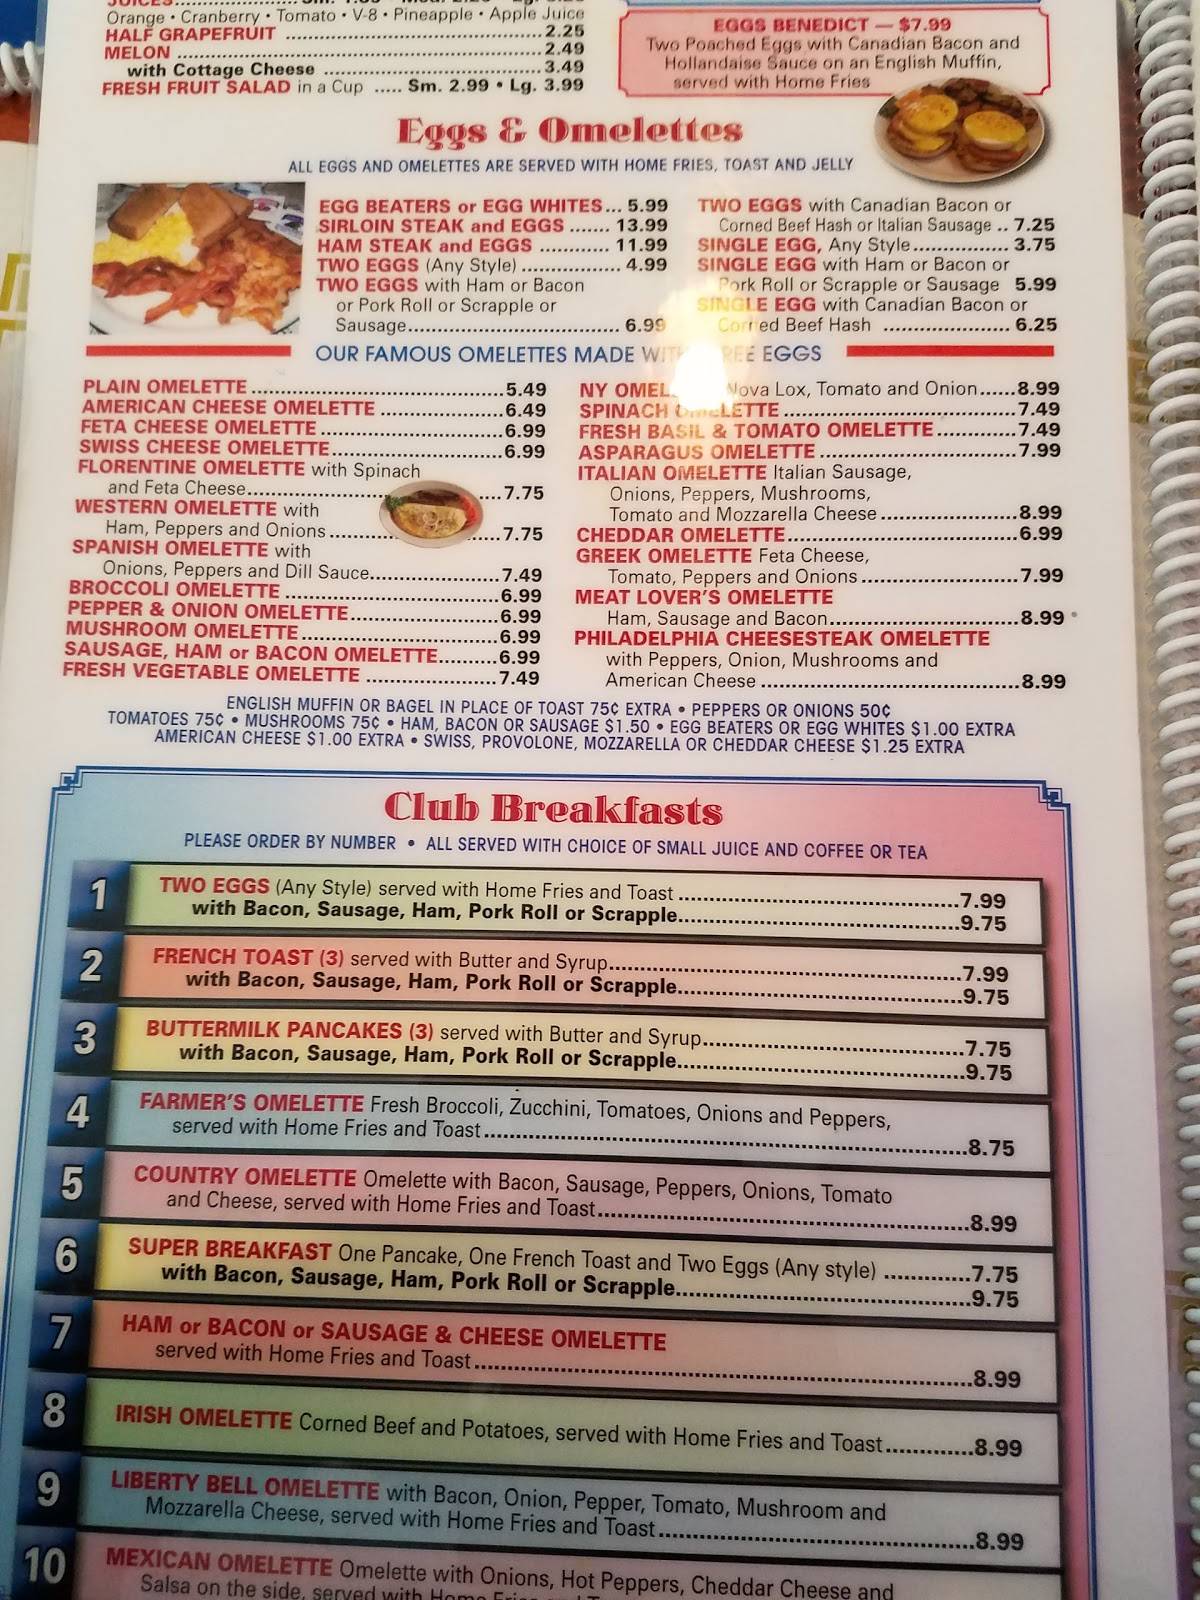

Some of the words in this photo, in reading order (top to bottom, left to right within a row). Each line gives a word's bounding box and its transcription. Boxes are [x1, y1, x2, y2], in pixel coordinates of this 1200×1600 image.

[106, 10, 166, 29] Orange
[180, 9, 261, 27] Cranberry
[276, 7, 336, 23] Tomato
[352, 7, 378, 22] V-8
[393, 6, 473, 25] Pineapple
[489, 5, 537, 24] Apple
[541, 4, 586, 21] Juice
[713, 17, 767, 34] EGGS
[772, 16, 870, 33] BENEDICT
[898, 16, 952, 35] $7.99
[105, 27, 156, 43] HALF
[158, 26, 277, 42] GRAPEFRUIT
[544, 23, 585, 38] 2.25
[646, 36, 680, 52] Two
[685, 36, 756, 52] Poached
[761, 35, 802, 55] Eggs
[806, 35, 843, 52] with
[848, 35, 927, 51] Canadian
[932, 34, 984, 51] Bacon
[988, 34, 1020, 51] and
[127, 63, 167, 78] with
[172, 62, 244, 80] Cottage
[250, 61, 315, 76] Cheese
[544, 59, 585, 74] 3.49
[665, 54, 762, 71] Hollandaise
[767, 54, 818, 70] Sauce
[822, 57, 844, 71] on
[849, 58, 870, 70] an
[874, 53, 936, 73] English
[942, 53, 1002, 71] Muffin,
[101, 80, 161, 96] FRESH
[166, 79, 221, 96] FRUIT
[226, 79, 291, 95] SALAD
[297, 79, 312, 94] in
[317, 82, 326, 94] a
[331, 78, 364, 97] Cup
[407, 77, 443, 93] Sm.
[449, 78, 490, 93] 2.99
[509, 77, 537, 96] Lg.
[544, 77, 584, 92] 3.99
[397, 116, 488, 152] Eggs
[498, 116, 528, 144] &
[538, 115, 744, 144] Omelettes
[287, 160, 313, 174] ALL
[318, 159, 358, 174] EGGS
[361, 159, 394, 174] AND
[398, 158, 481, 174] OMELETTES
[484, 158, 514, 173] ARE
[518, 158, 576, 173] SERVED
[580, 158, 619, 173] WITH
[624, 157, 668, 173] HOME
[672, 157, 718, 173] FRIES,
[724, 157, 770, 172] TOAST
[774, 157, 807, 172] AND
[811, 157, 854, 172] JELLY
[319, 199, 359, 214] EGG
[365, 198, 451, 214] BEATERS
[457, 202, 477, 215] or
[482, 198, 524, 214] EGG
[529, 197, 603, 214] WHITES
[627, 198, 669, 213] 5.99
[698, 237, 769, 253] SINGLE
[775, 236, 822, 255] EGG,
[828, 236, 863, 256] Any
[867, 236, 911, 256] Style
[1013, 237, 1056, 252] 3.75
[315, 344, 359, 362] OUR
[365, 345, 452, 363] FAMOUS
[457, 345, 568, 364] OMELETTES
[574, 345, 635, 364] MADE
[762, 344, 822, 363] EGGS
[83, 378, 141, 394] PLAIN
[146, 378, 248, 395] OMELETTE
[506, 382, 547, 397] 5.49
[576, 527, 674, 543] CHEDDAR
[680, 526, 786, 543] OMELETTE
[1019, 525, 1063, 541] 6.99
[607, 609, 651, 628] Ham,
[657, 610, 731, 630] Sausage
[735, 610, 768, 626] and
[774, 610, 828, 626] Bacon
[1020, 609, 1065, 626] 8.99
[574, 630, 720, 647] PHILADELPHIA
[725, 630, 873, 647] CHEESESTEAK
[880, 630, 991, 647] OMELETTE
[62, 661, 126, 678] FRESH
[132, 662, 250, 681] VEGETABLE
[255, 665, 361, 683] OMELETTE
[499, 670, 540, 686] 7.49
[154, 728, 236, 745] AMERICAN
[241, 730, 302, 746] CHEESE
[306, 730, 353, 747] $1.00
[358, 732, 405, 748] EXTRA
[423, 733, 476, 750] SWISS,
[482, 734, 578, 752] PROVOLONE,
[584, 735, 681, 751] MOZZARELLA
[685, 736, 707, 752] OR
[712, 737, 789, 753] CHEDDAR
[794, 737, 856, 753] CHEESE
[861, 737, 910, 755] $1.25
[915, 738, 966, 754] EXTRA
[384, 791, 480, 822] Club
[489, 793, 724, 826] Breakfasts
[89, 878, 109, 913] 1
[159, 876, 207, 894] TWO
[212, 877, 270, 895] EGGS
[276, 878, 317, 899] (Any
[321, 878, 372, 900] Style)
[378, 880, 437, 897] served
[441, 880, 479, 897] with
[485, 881, 537, 899] Home
[542, 882, 584, 900] Fries
[589, 883, 621, 900] and
[626, 883, 674, 901] Toast
[959, 892, 1006, 910] 7.99
[78, 948, 104, 983] 2
[72, 1020, 98, 1056] 3
[146, 1019, 281, 1038] BUTTERMILK
[286, 1021, 403, 1040] PANCAKES
[409, 1022, 434, 1042] (3)
[964, 1039, 1012, 1058] 7.75
[64, 1093, 91, 1129] 4
[139, 1092, 247, 1112] FARMER'S
[253, 1093, 365, 1113] OMELETTE
[965, 1138, 1015, 1157] 8.75
[59, 1165, 85, 1202] 5
[134, 1164, 240, 1185] COUNTRY
[244, 1167, 358, 1188] OMELETTE
[969, 1214, 1018, 1233] 8.99
[53, 1236, 79, 1274] 6
[127, 1236, 199, 1257] SUPER
[205, 1239, 333, 1261] BREAKFAST
[48, 1314, 74, 1351] 7
[122, 1313, 173, 1334] HAM
[179, 1320, 202, 1335] or
[207, 1317, 286, 1338] BACON
[292, 1325, 315, 1339] or
[320, 1320, 429, 1343] SAUSAGE
[434, 1324, 453, 1344] &
[458, 1325, 544, 1348] CHEESE
[551, 1328, 667, 1352] OMELETTE
[973, 1369, 1022, 1389] 8.99
[41, 1392, 67, 1429] 8
[36, 1470, 61, 1508] 9
[111, 1469, 200, 1492] LIBERTY
[206, 1474, 259, 1496] BELL
[264, 1476, 380, 1501] OMELETTE
[22, 1545, 69, 1586] 10
[106, 1546, 211, 1571] MEXICAN
[217, 1553, 334, 1577] OMELETTE
